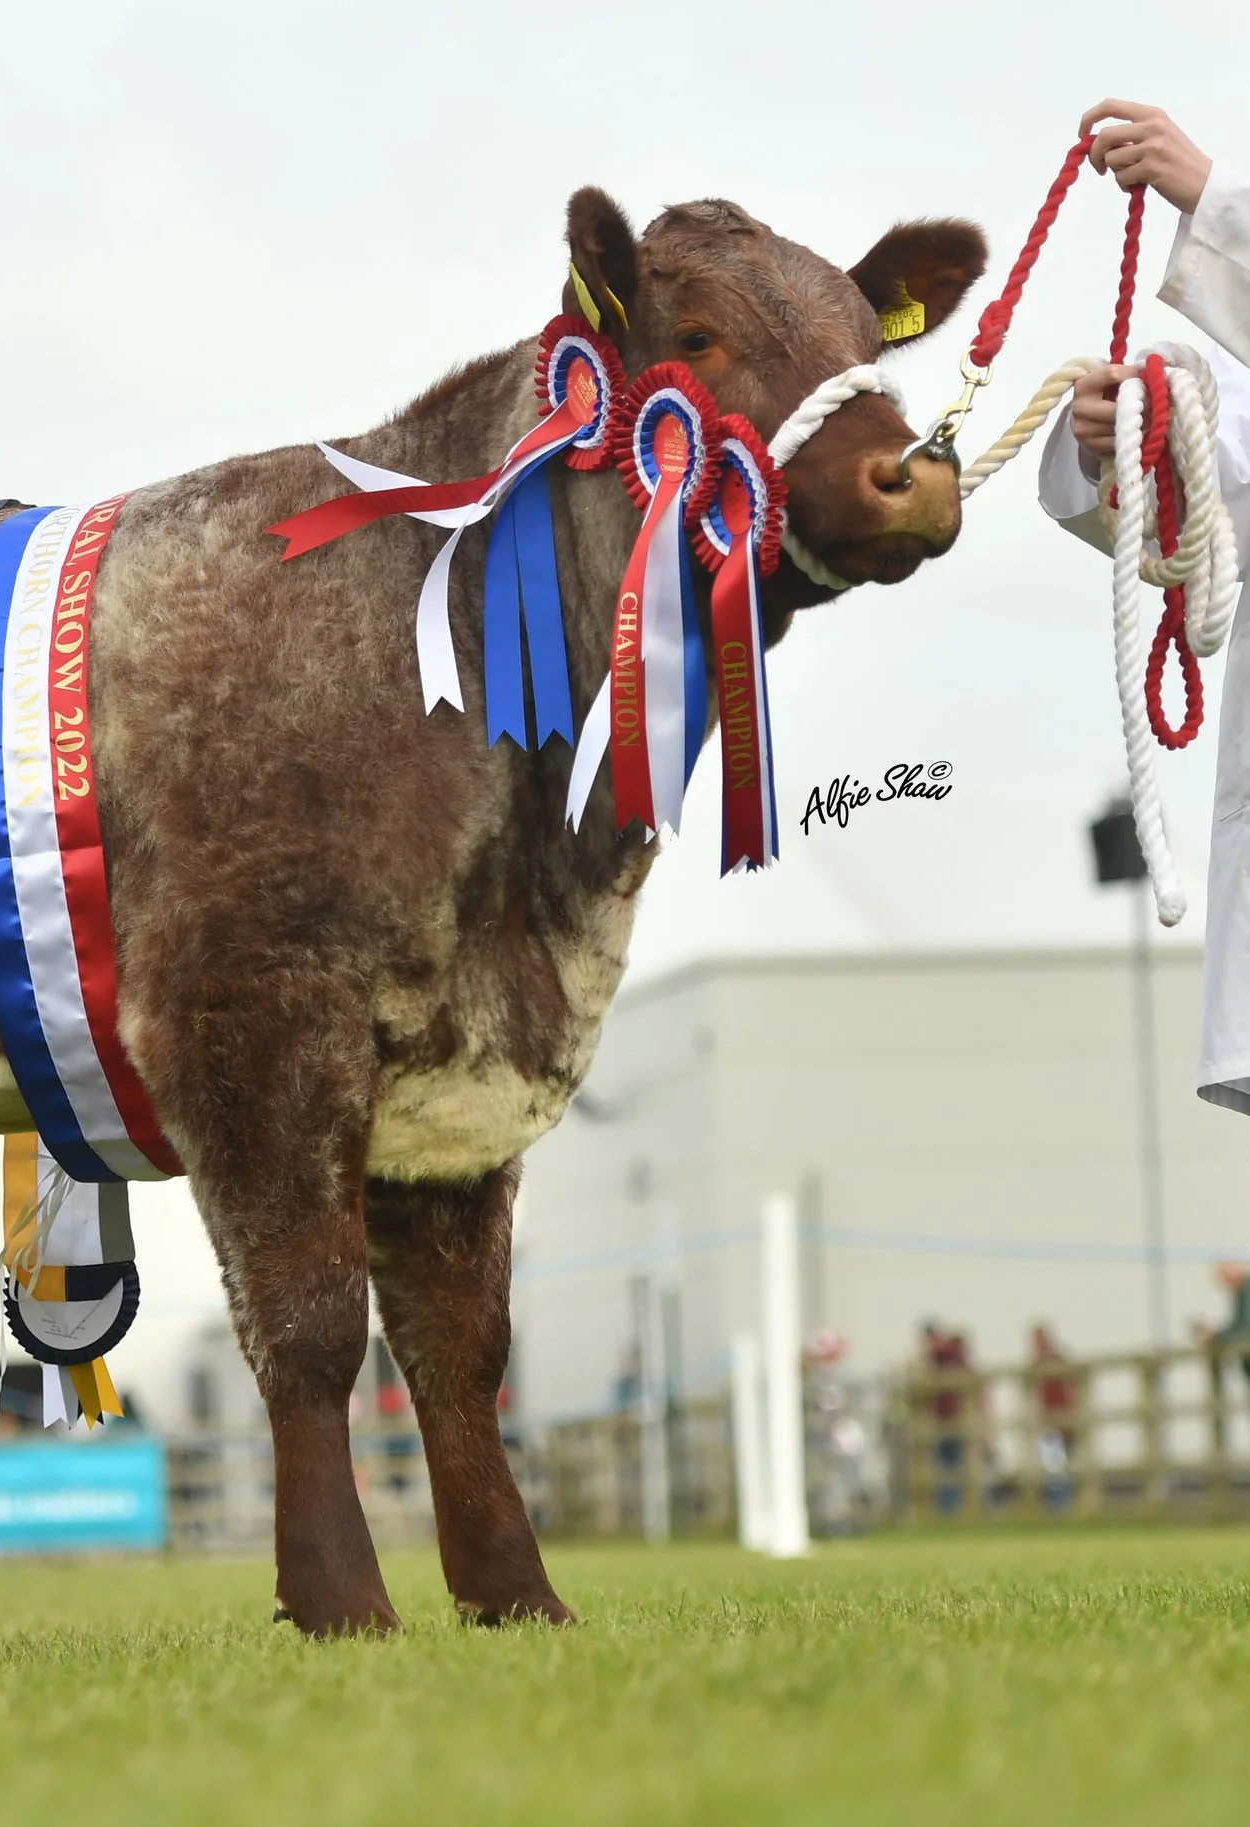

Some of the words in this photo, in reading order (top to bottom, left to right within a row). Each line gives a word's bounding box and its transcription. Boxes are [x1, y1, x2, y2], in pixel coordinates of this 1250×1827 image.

[912, 314, 920, 332] 5
[53, 570, 91, 693] SHOW
[615, 591, 640, 747] CHAMPION
[14, 621, 43, 808] CHAMPION
[53, 706, 90, 800] 2022
[721, 641, 756, 790] CHAMPION
